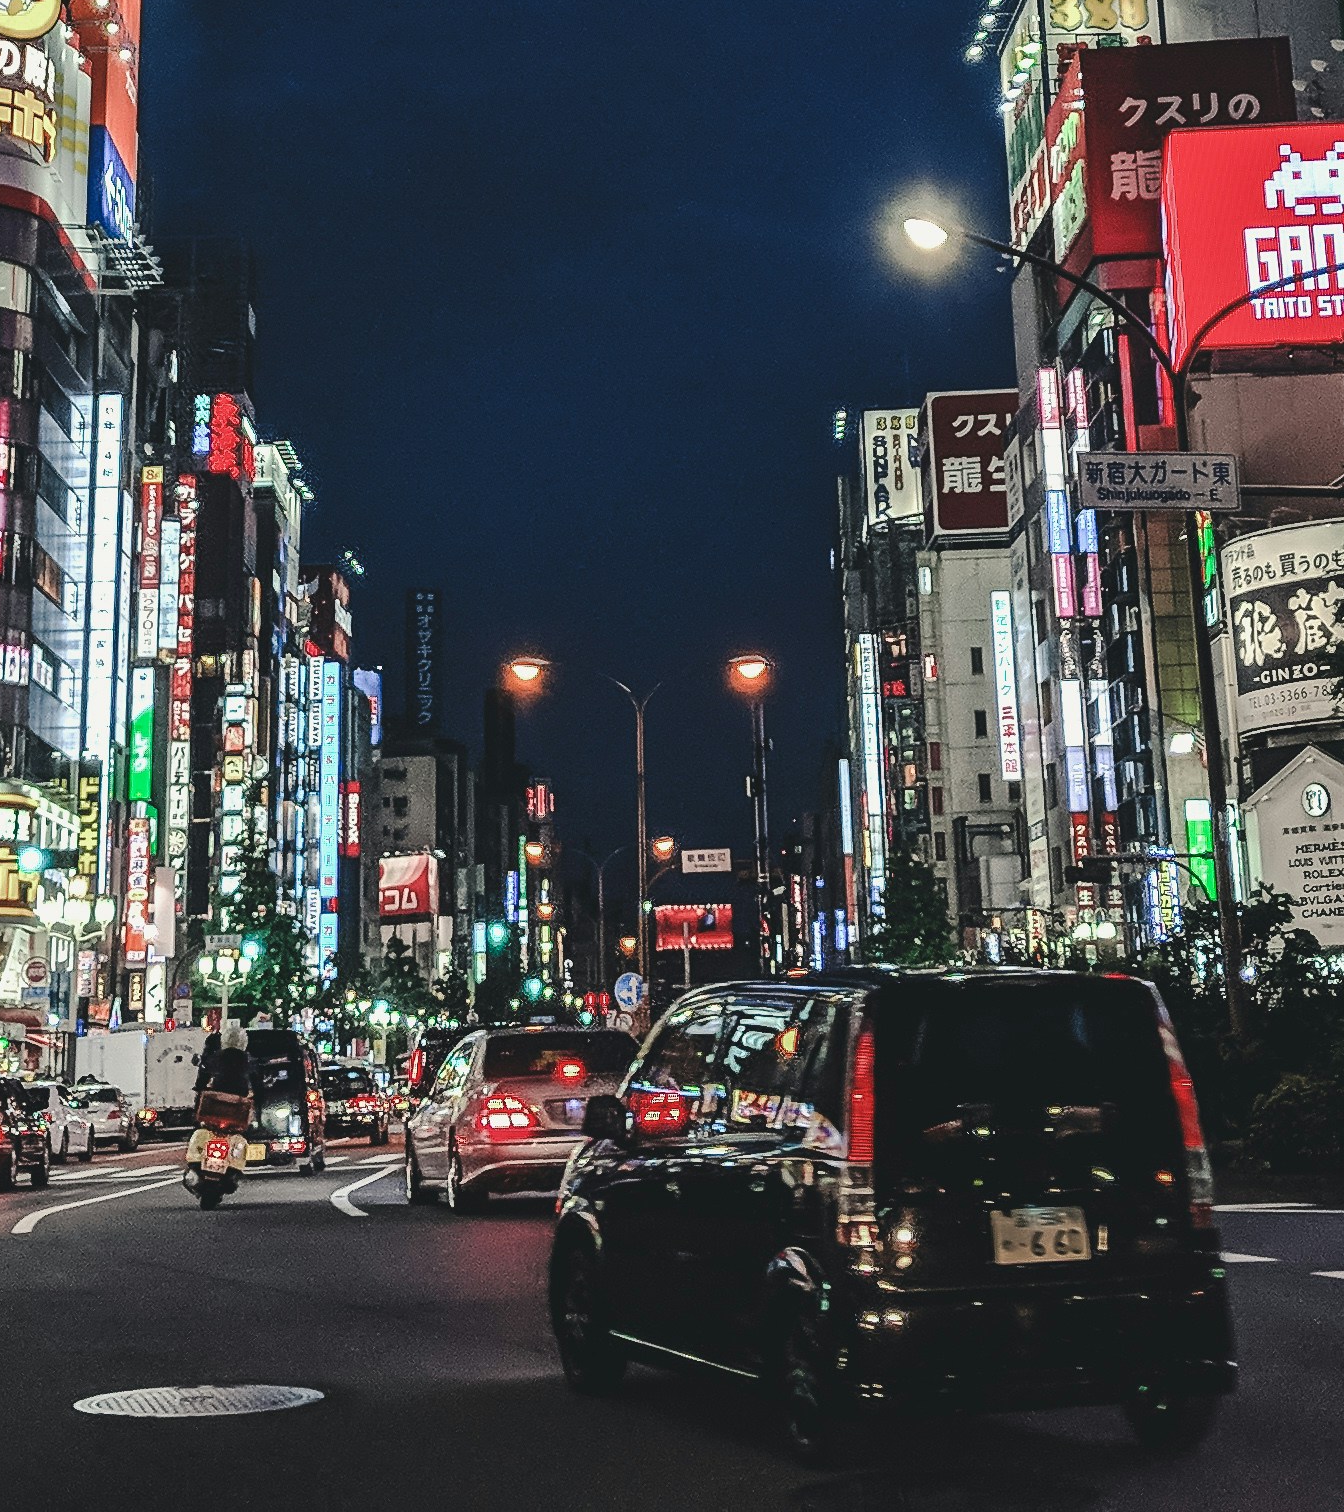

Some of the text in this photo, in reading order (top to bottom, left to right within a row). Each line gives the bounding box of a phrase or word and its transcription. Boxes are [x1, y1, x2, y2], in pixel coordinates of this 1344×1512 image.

[1118, 92, 1261, 128] クスリの
[1250, 295, 1312, 320] TAITO
[1085, 459, 1232, 486] 新宿大ガード東
[1231, 561, 1277, 590] 売るのも
[310, 658, 321, 698] TSUTAYA
[309, 702, 320, 745] TSUTAYA
[1288, 857, 1314, 868] LOUIS
[379, 888, 418, 911] コム
